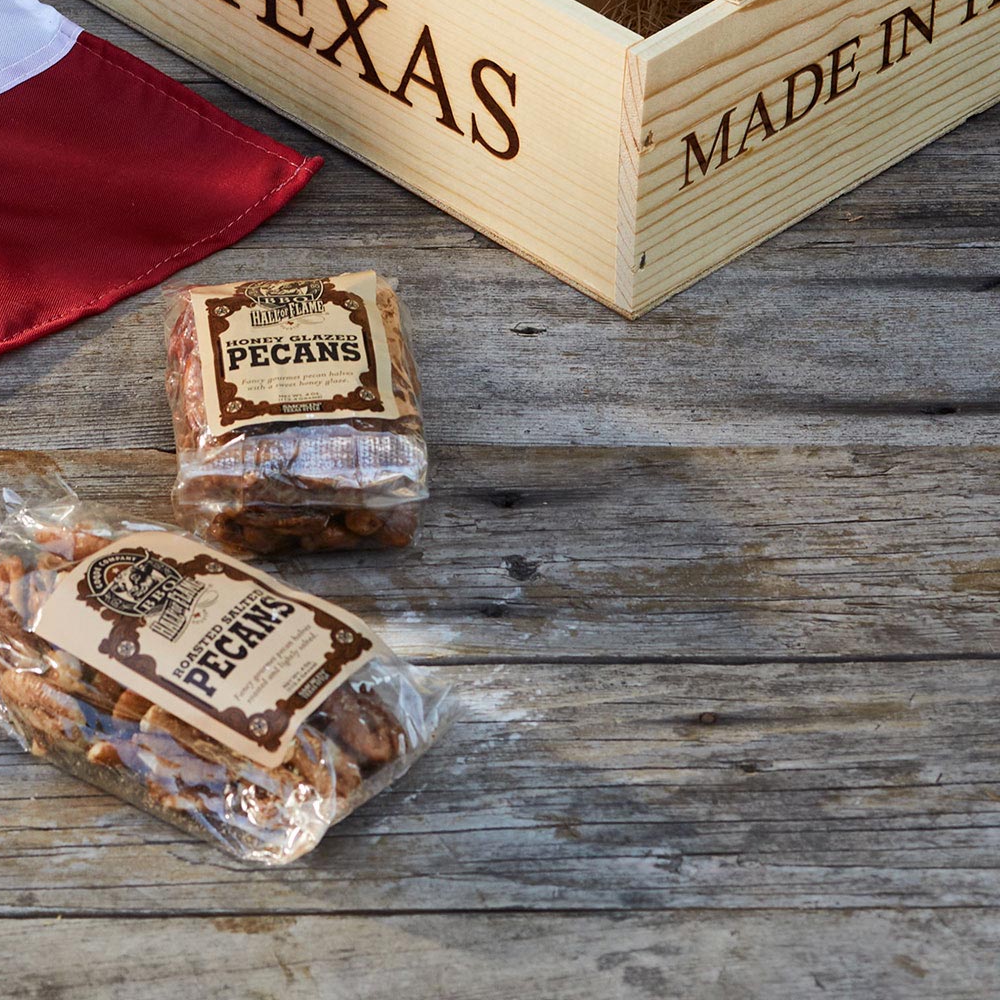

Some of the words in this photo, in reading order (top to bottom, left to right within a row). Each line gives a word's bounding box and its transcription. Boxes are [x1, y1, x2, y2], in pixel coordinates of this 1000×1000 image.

[679, 35, 861, 191] MADE
[250, 309, 280, 326] HALL
[288, 301, 325, 318] FLAME
[226, 336, 284, 347] HONEY
[227, 342, 361, 371] PECANS
[268, 376, 300, 384] gourmet
[99, 556, 136, 566] COMPANY
[142, 580, 176, 609] BBQ
[173, 624, 223, 678] ROASTED
[222, 589, 264, 624] SALTED
[184, 596, 295, 697] PECANS
